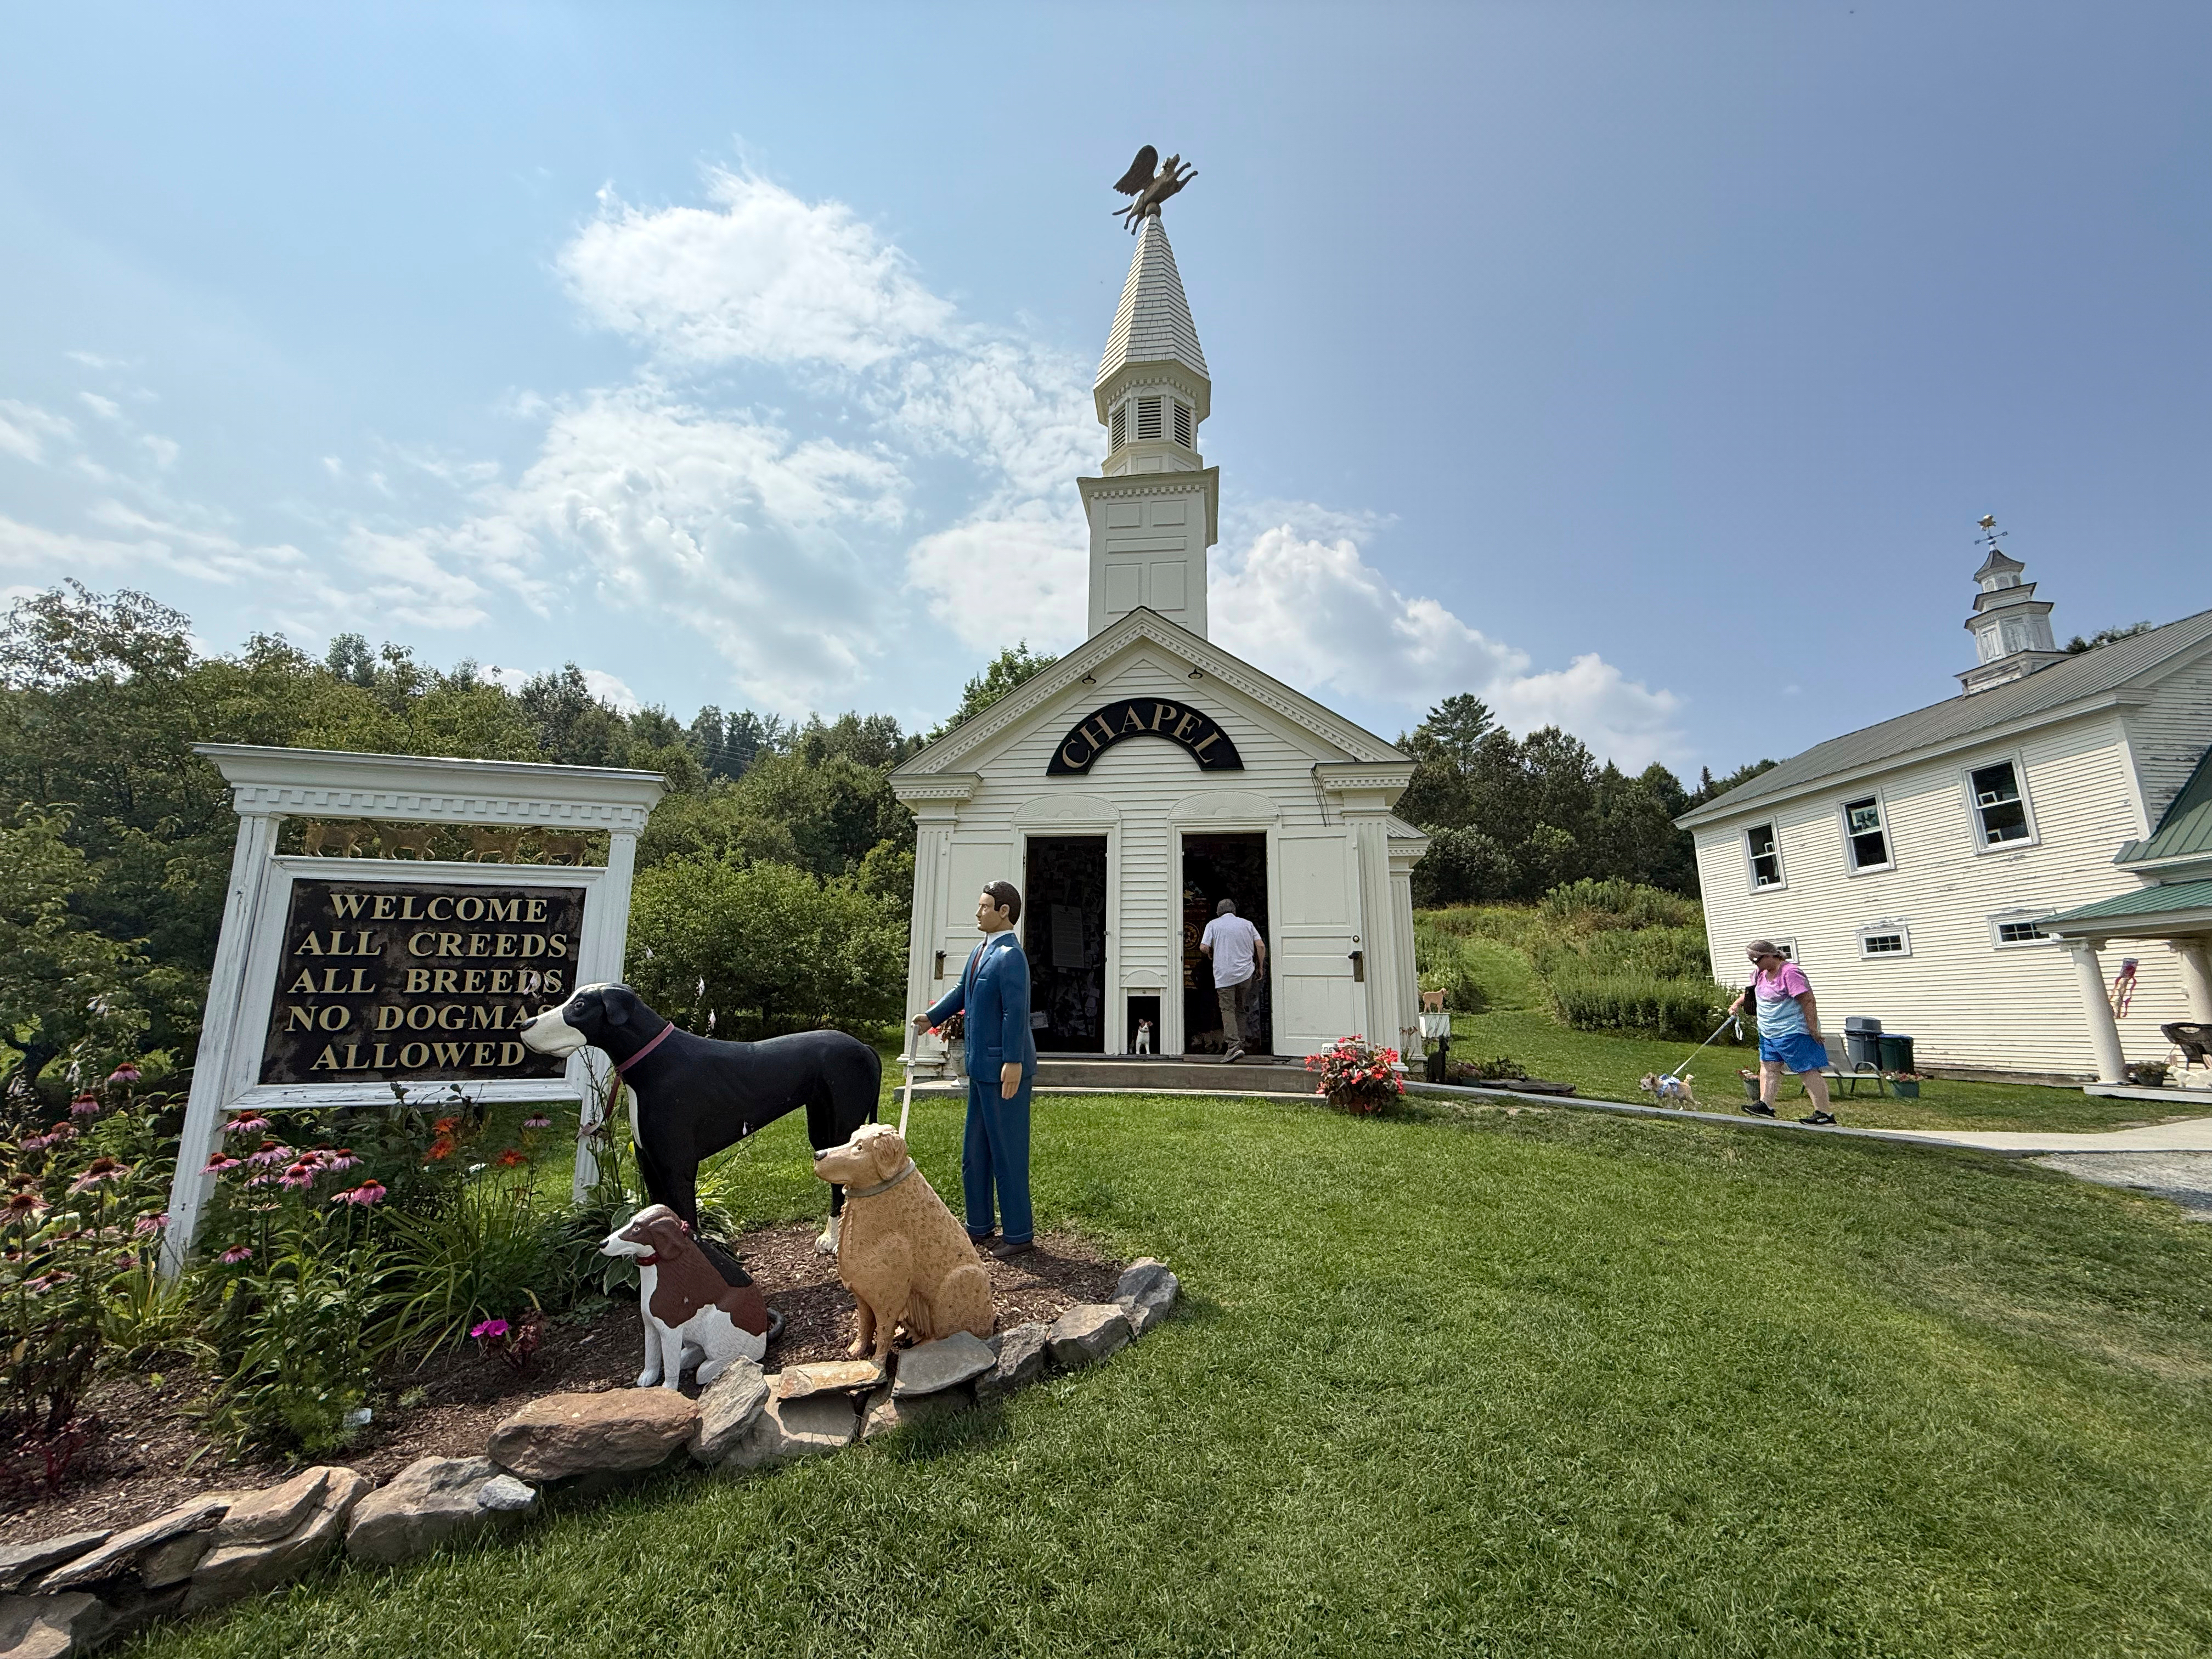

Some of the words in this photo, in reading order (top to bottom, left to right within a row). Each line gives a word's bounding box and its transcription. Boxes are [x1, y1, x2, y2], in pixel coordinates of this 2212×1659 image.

[1062, 704, 1223, 768] CHAPEL
[330, 894, 548, 922] WELCOME
[294, 931, 381, 956] ALL
[408, 933, 567, 957] CREEDS
[287, 968, 375, 993] ALL
[403, 969, 562, 994] BREEDS
[285, 1006, 351, 1031] NO
[311, 1042, 525, 1070] ALLOWED
